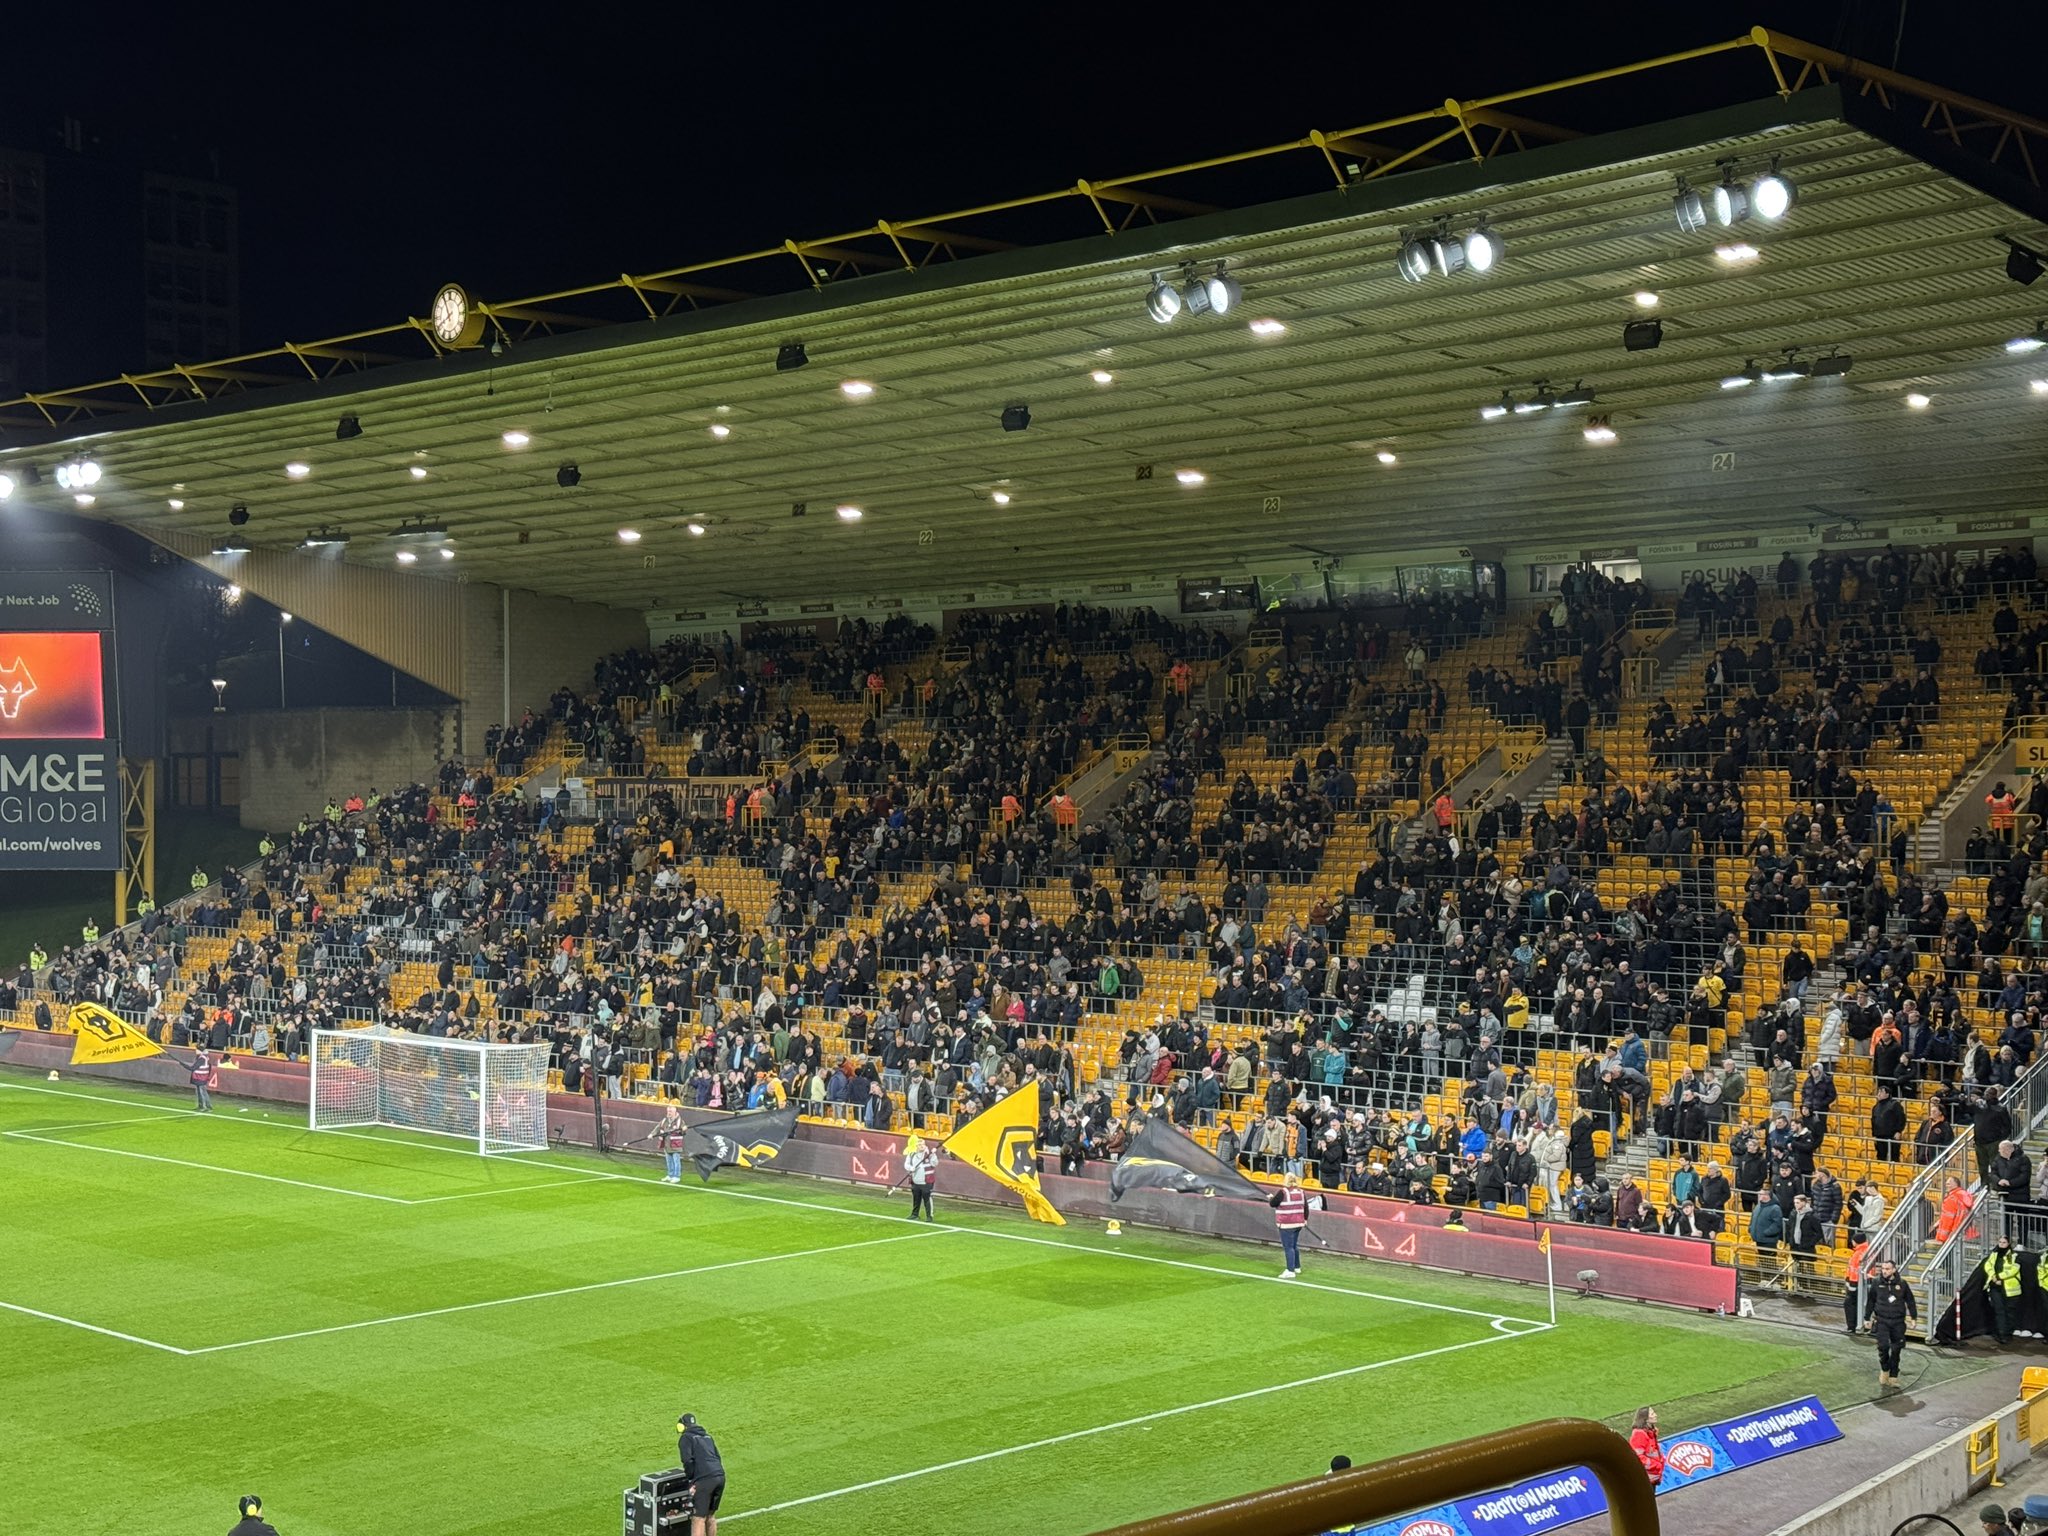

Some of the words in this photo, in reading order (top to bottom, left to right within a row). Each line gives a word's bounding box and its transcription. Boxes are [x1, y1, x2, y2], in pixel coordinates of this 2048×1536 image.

[1714, 454, 1732, 470] 24
[1265, 498, 1278, 512] 23
[920, 531, 932, 543] 22
[1535, 553, 1557, 561] FOSUN
[1649, 545, 1671, 554] FOSUN
[6, 594, 35, 606] Next
[37, 594, 60, 606] Job
[1, 754, 105, 792] M&E
[1, 796, 106, 823] Global
[1769, 1430, 1798, 1449] Resort
[1670, 1443, 1711, 1467] THOMAS
[1683, 1454, 1706, 1473] LAND
[1523, 1504, 1561, 1527] Resort
[1402, 1524, 1450, 1536] HOMAS
